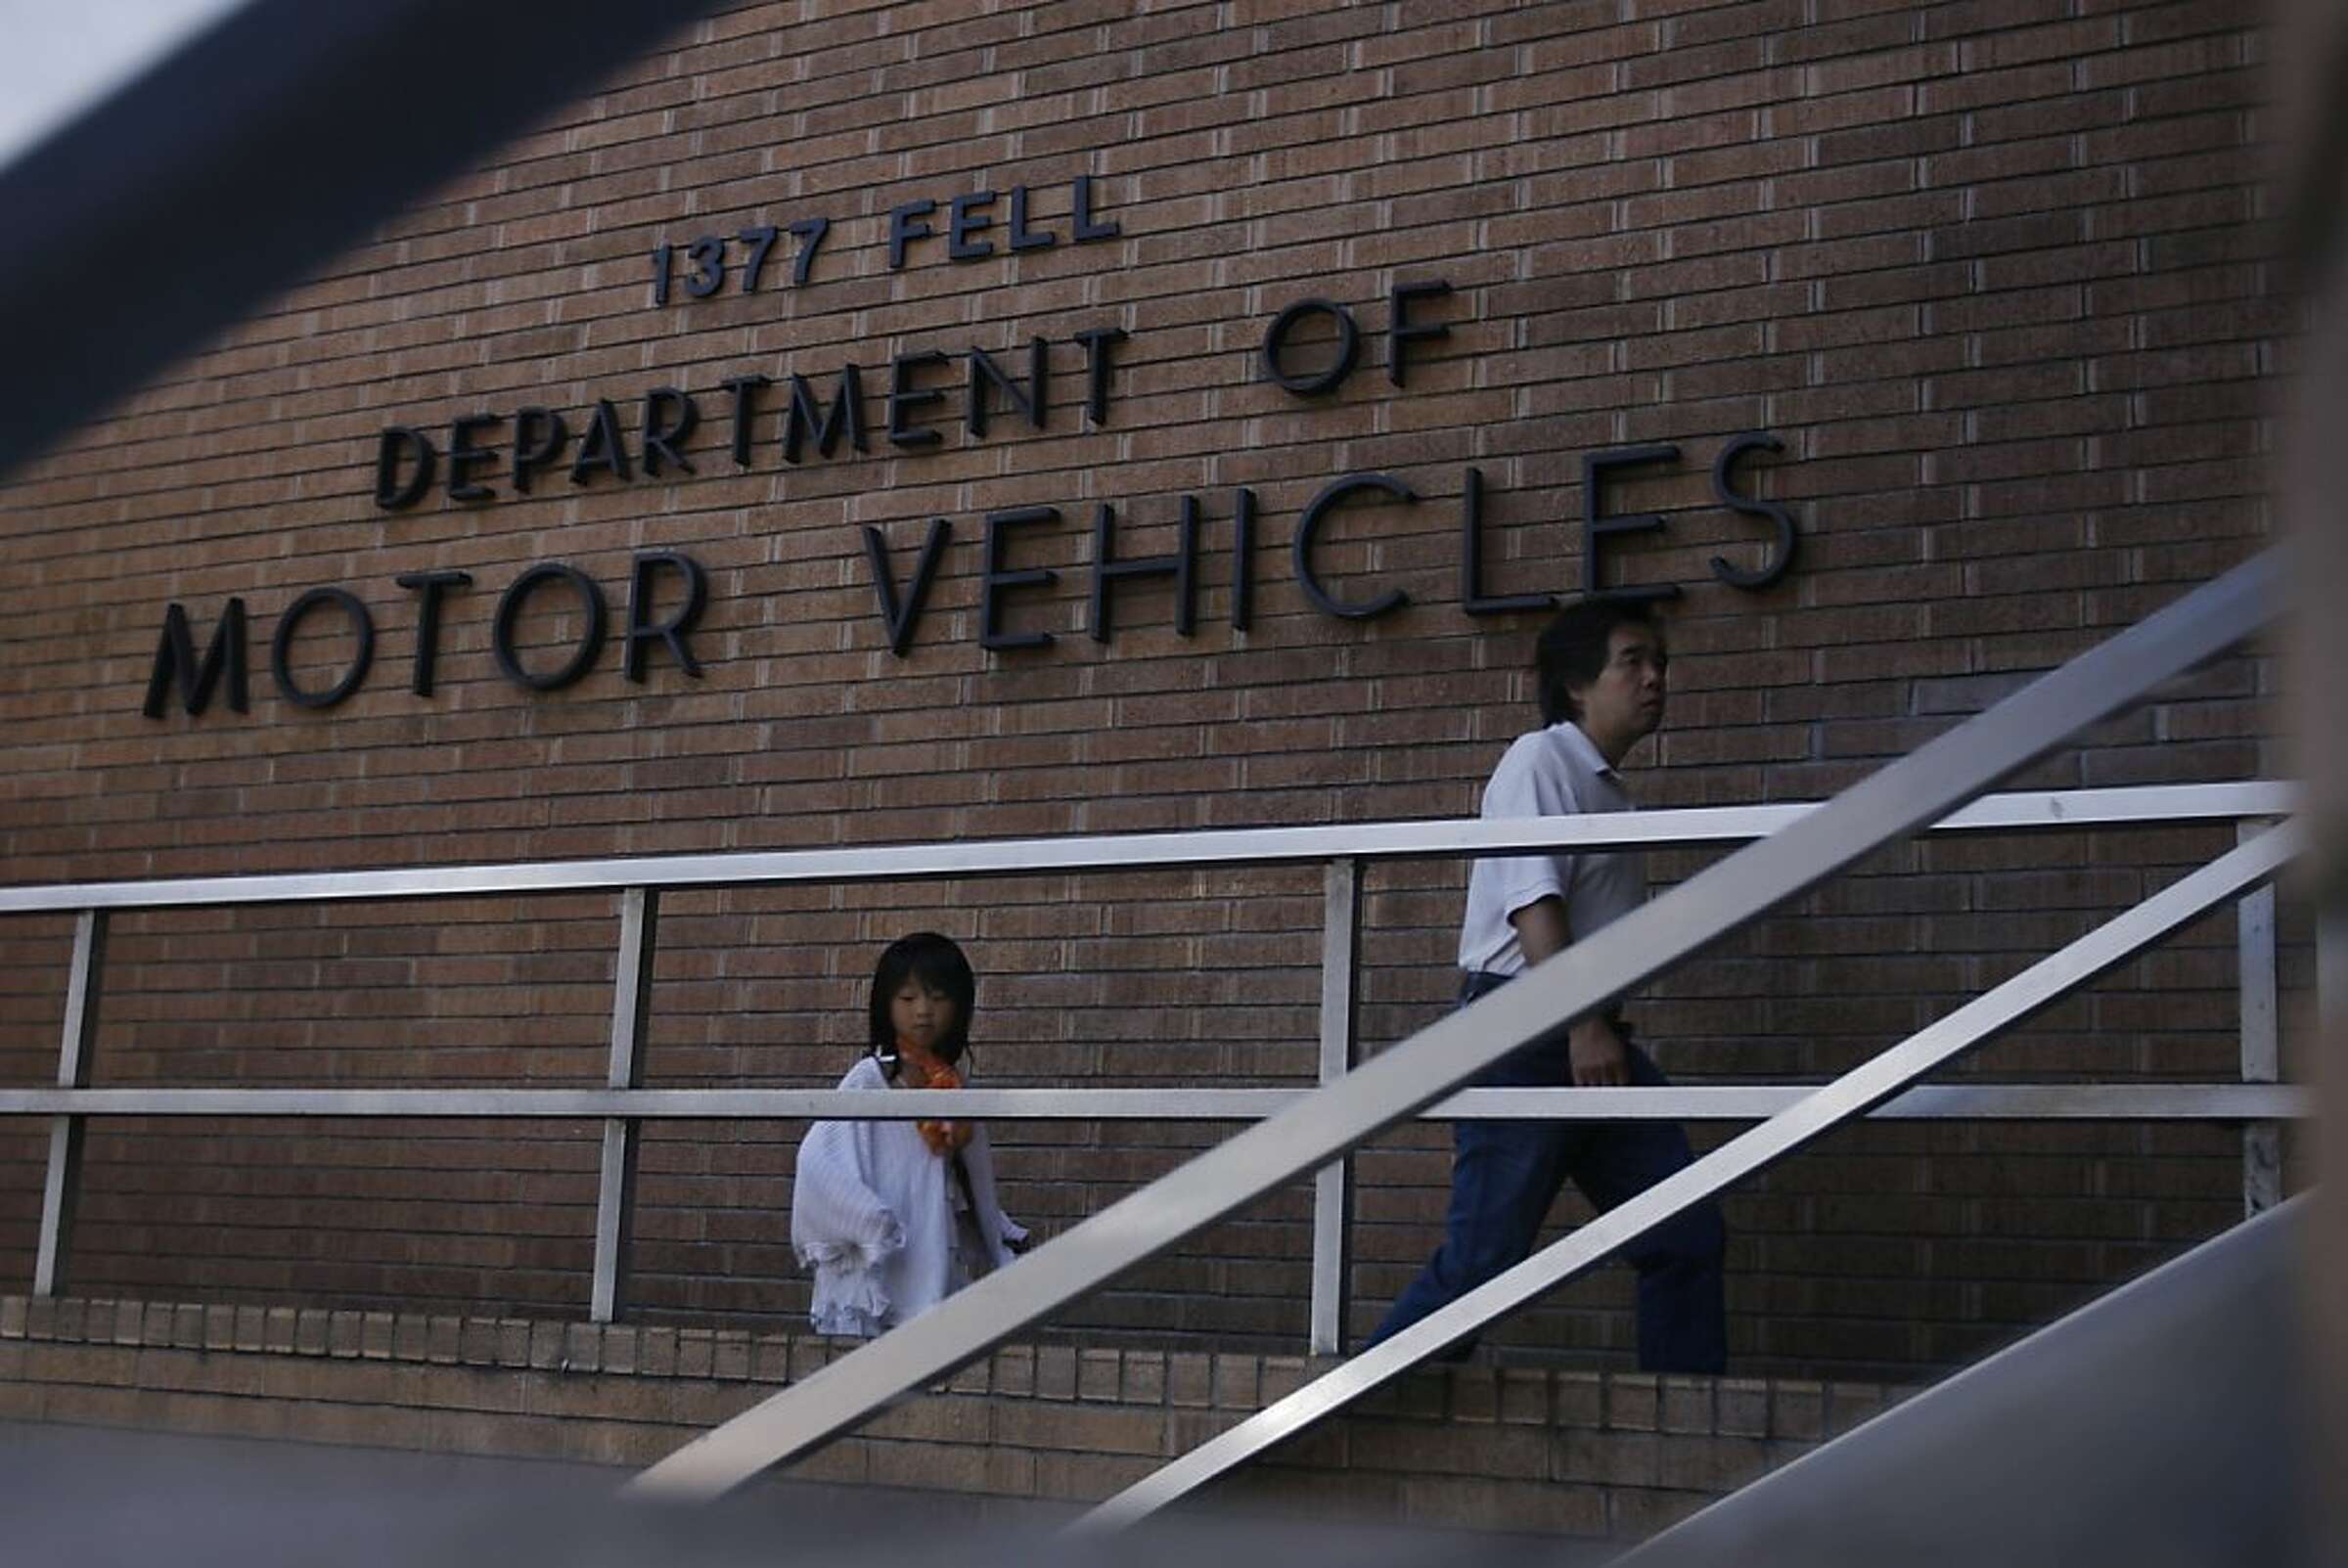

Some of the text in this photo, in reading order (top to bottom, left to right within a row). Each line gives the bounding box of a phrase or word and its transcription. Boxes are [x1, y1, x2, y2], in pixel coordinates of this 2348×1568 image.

[652, 174, 1120, 307] 1377 FELL
[376, 280, 1452, 510] DEPARTMENT OF
[143, 431, 1798, 719] MOTOR VEHICLES
